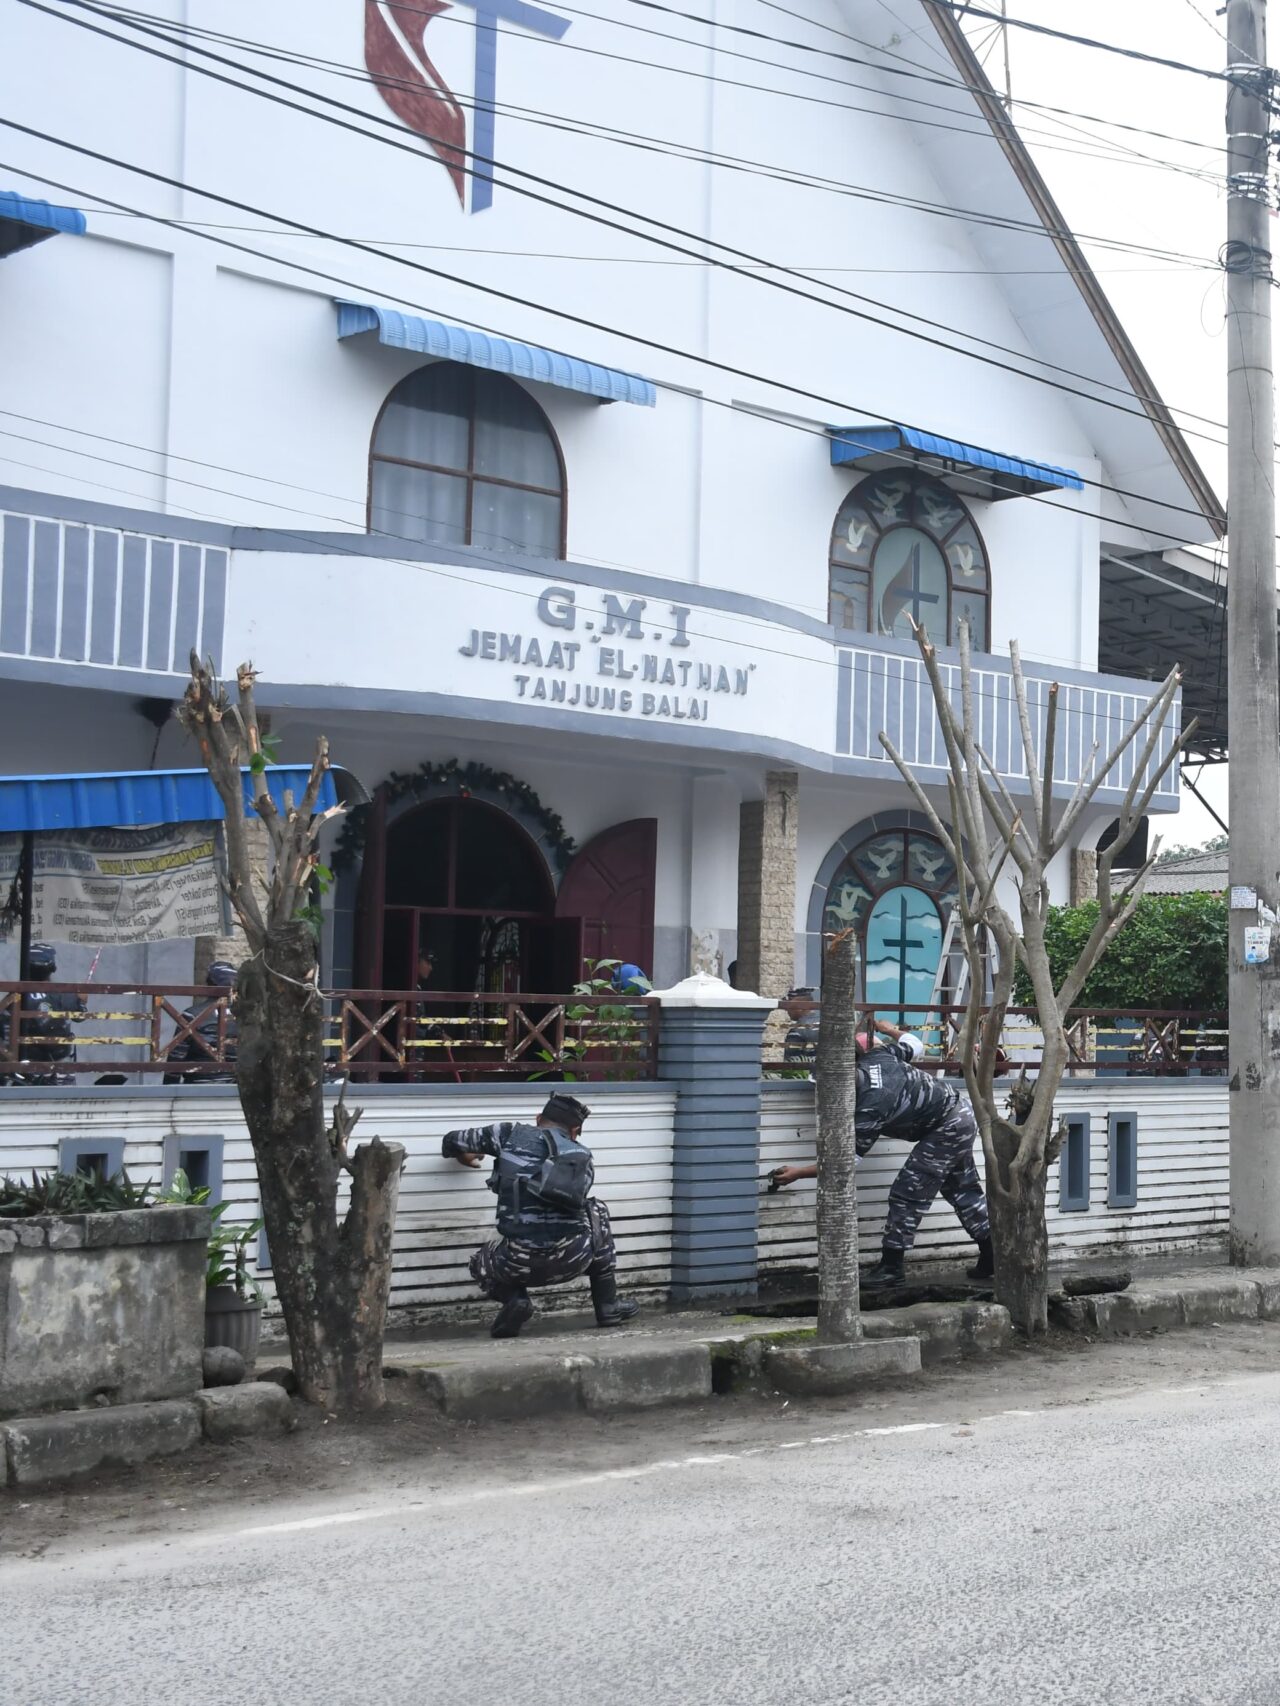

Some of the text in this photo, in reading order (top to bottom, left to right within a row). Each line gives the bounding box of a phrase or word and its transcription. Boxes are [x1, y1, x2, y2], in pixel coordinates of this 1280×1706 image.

[536, 586, 692, 647] G.M.I
[458, 629, 581, 671] JEMAAT
[514, 674, 709, 721] TANJUNG BALAI
